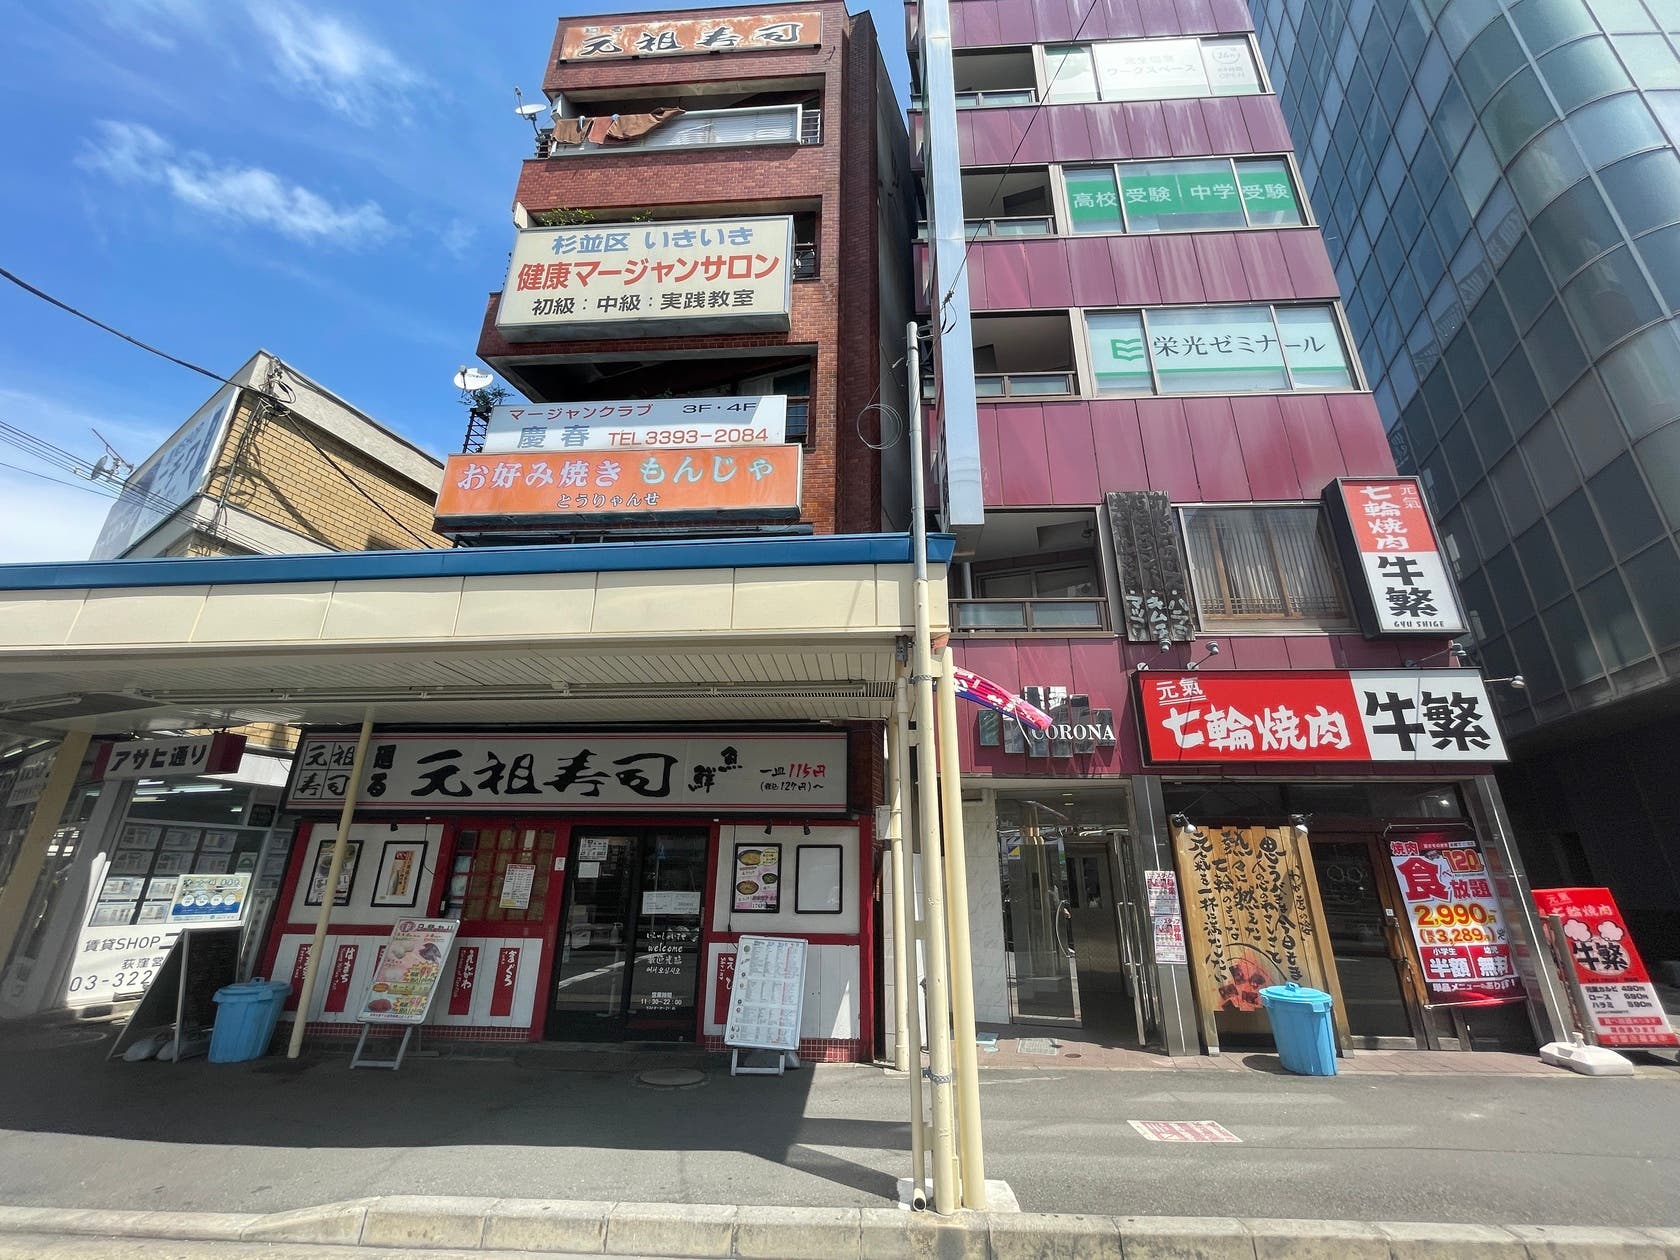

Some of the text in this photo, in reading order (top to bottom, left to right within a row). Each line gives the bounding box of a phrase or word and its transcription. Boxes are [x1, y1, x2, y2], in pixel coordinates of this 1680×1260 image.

[579, 22, 802, 56] 元祖寿司
[552, 226, 754, 256] 杉並区 いきいき
[517, 254, 780, 292] 健康マージャンサロン
[1153, 333, 1327, 358] 栄光ゼミナール
[509, 403, 654, 421] マージャンクラブ
[517, 424, 591, 449] 慶春
[458, 455, 775, 491] お好み焼き もんじゃ
[556, 491, 661, 508] とうりゃんせ
[1360, 485, 1410, 550] 七輪焼肉
[1377, 555, 1439, 618] 牛繁
[1393, 620, 1446, 628] GYU SHIGE
[1030, 723, 1117, 741] CORONA
[1162, 704, 1352, 752] 七輪焼肉
[1363, 690, 1493, 752] 牛繁
[109, 744, 208, 772] アサヒ通り
[305, 744, 355, 767] 元祖
[297, 772, 350, 797] 寿司
[410, 747, 680, 798] 元祖寿司
[83, 935, 161, 952] 賃貸SHOP
[648, 942, 683, 952] welcome
[1433, 946, 1458, 956] 小学生
[1572, 940, 1629, 971] 牛繁
[340, 947, 356, 983] はまち
[460, 949, 475, 989] えんがわ
[504, 950, 518, 987] まぐろ
[1429, 956, 1472, 979] 半額
[1477, 956, 1509, 977] 無料
